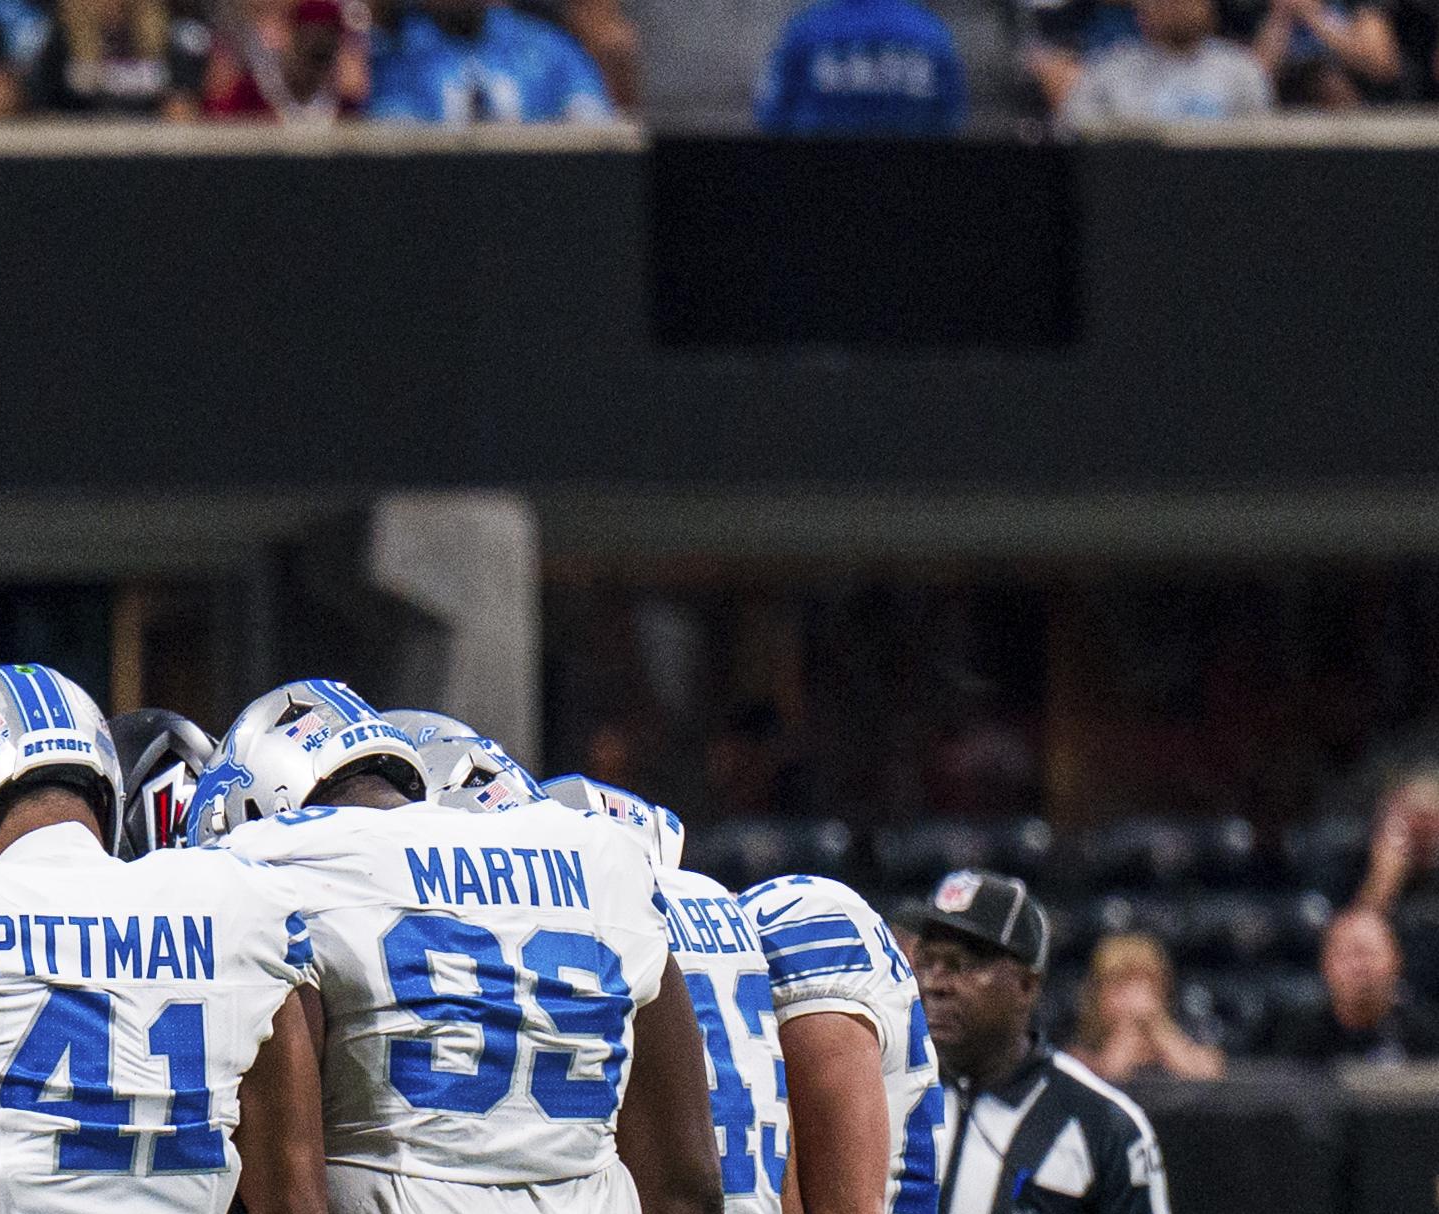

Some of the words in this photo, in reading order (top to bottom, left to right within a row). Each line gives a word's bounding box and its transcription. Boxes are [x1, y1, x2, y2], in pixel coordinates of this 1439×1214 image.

[23, 738, 93, 757] DETROIT
[406, 847, 589, 910] MARTIN
[377, 912, 636, 1123] 99
